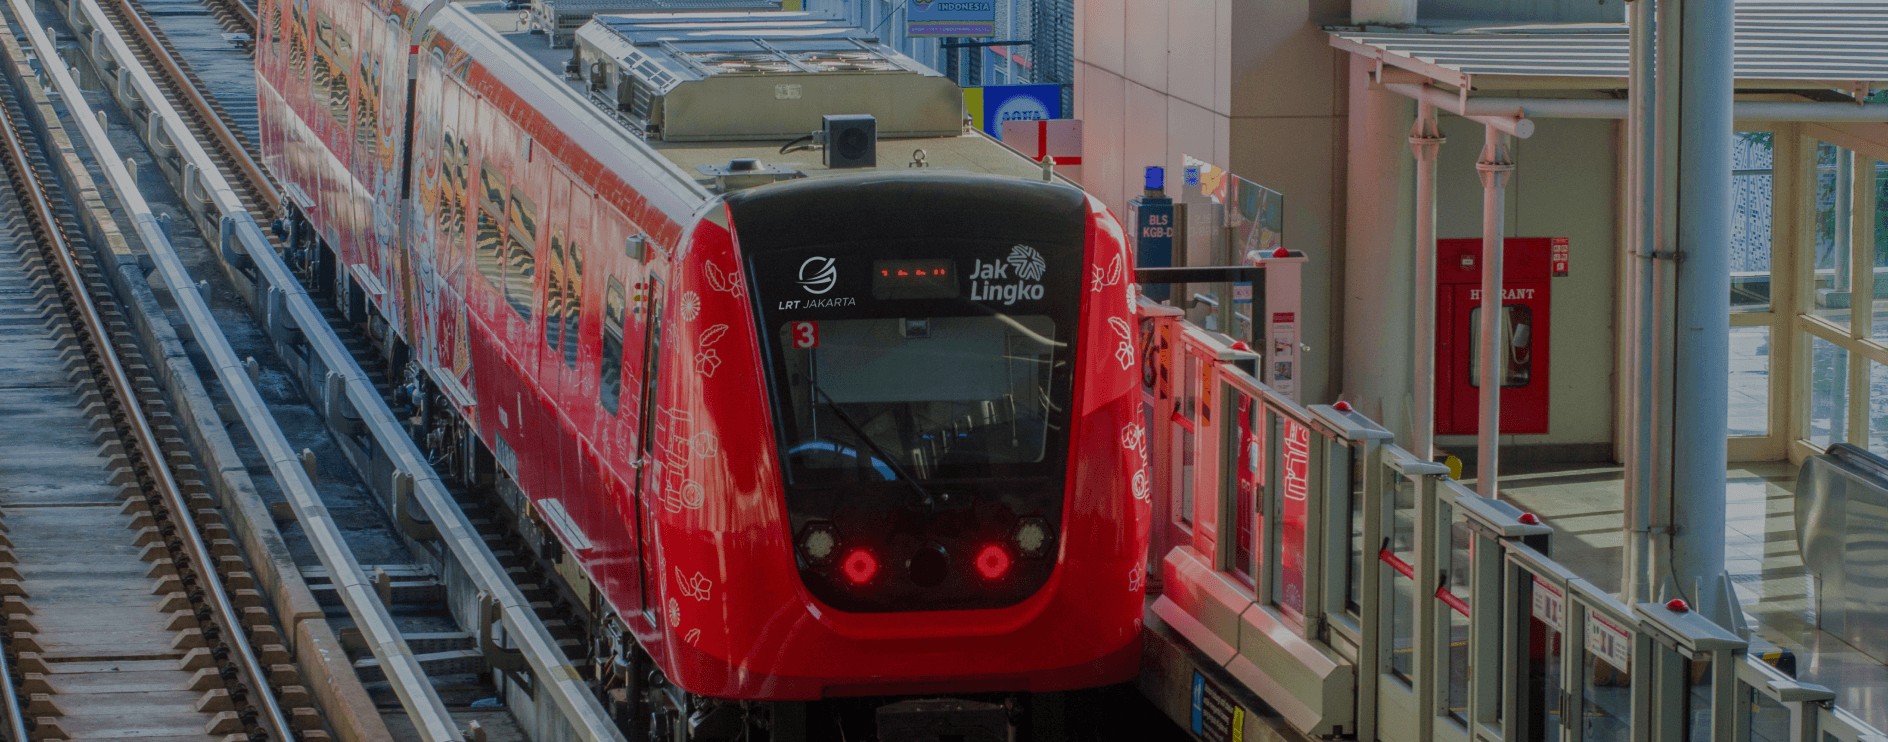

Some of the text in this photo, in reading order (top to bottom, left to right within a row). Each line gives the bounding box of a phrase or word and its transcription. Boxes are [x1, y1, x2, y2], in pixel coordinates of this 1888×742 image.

[938, 2, 991, 11] INDONESIA
[1149, 214, 1168, 226] BLS
[1143, 226, 1173, 238] KGB-D
[969, 258, 1008, 280] Jak
[970, 280, 1045, 306] Lingko
[1470, 288, 1535, 300] HRANT
[778, 296, 856, 311] LRT JAKARTA
[796, 321, 815, 349] 3
